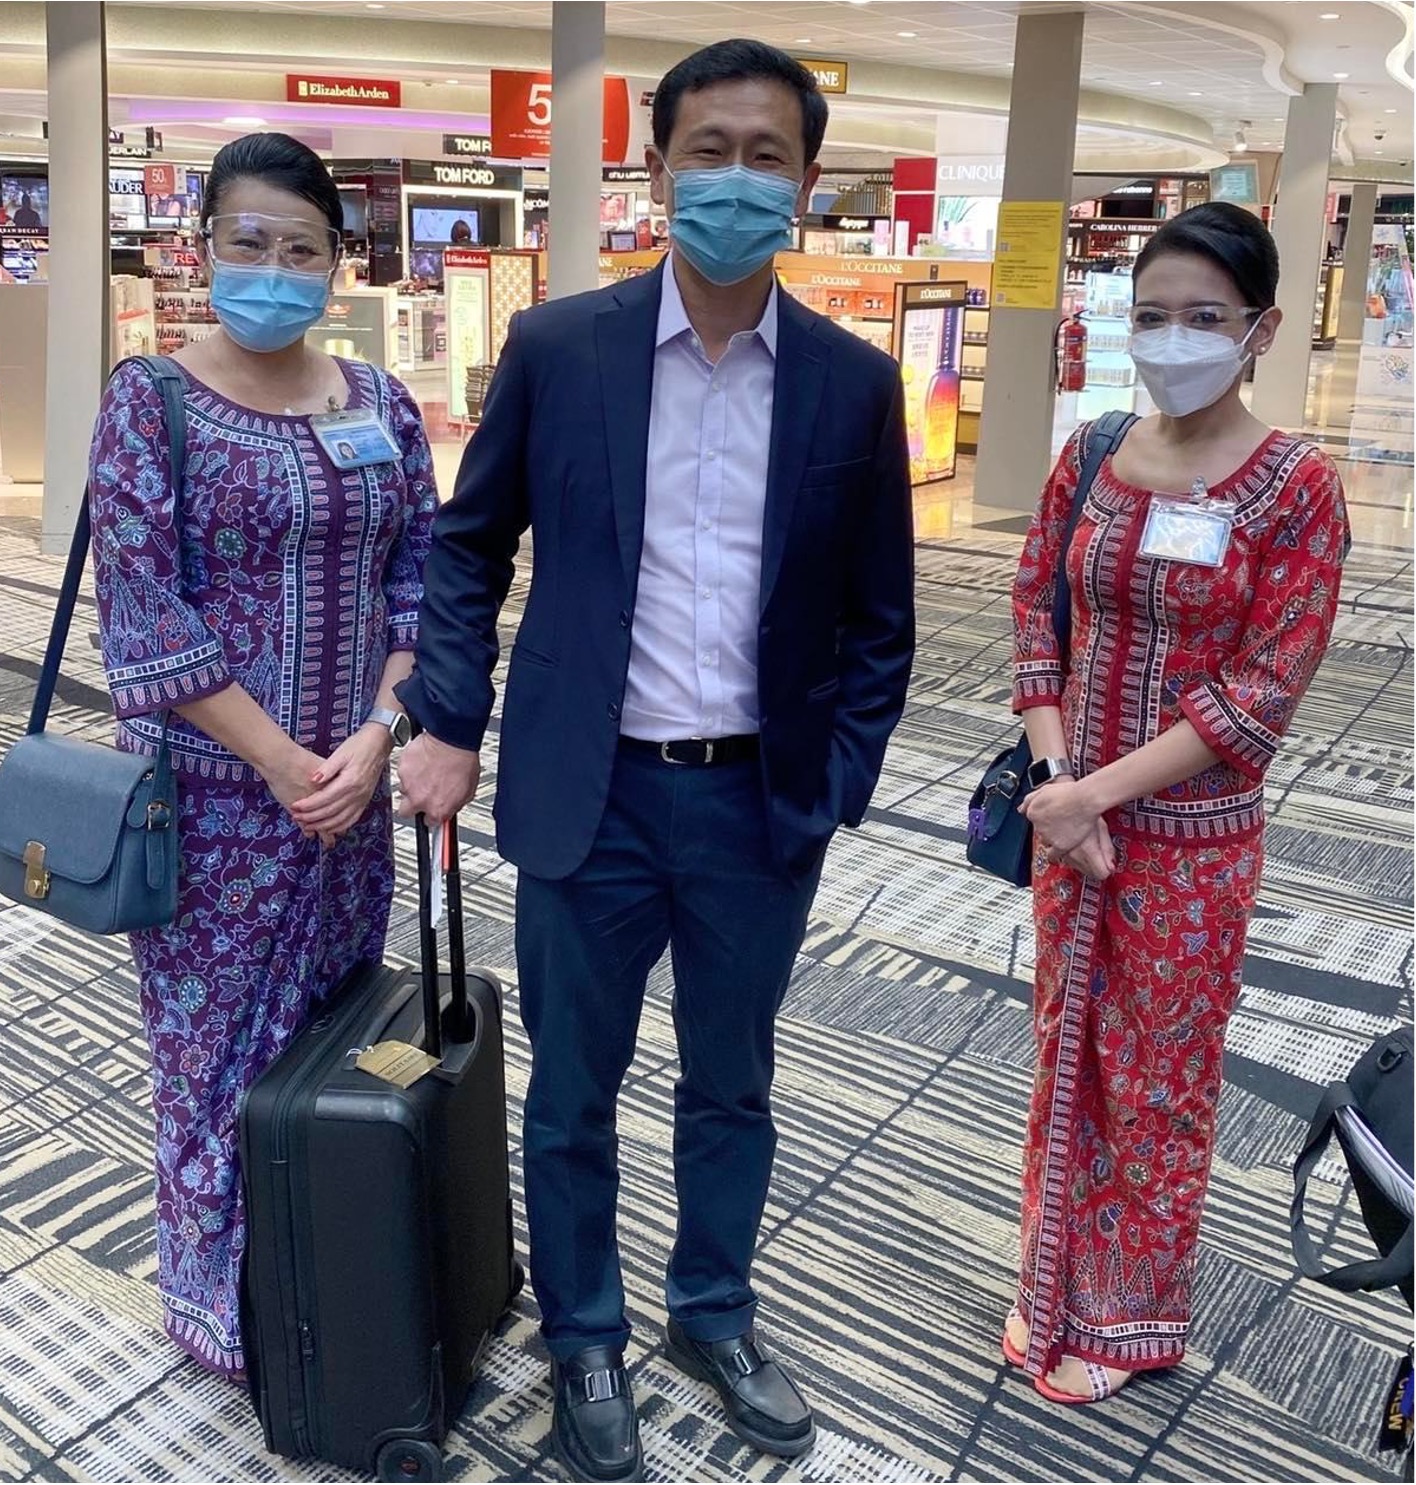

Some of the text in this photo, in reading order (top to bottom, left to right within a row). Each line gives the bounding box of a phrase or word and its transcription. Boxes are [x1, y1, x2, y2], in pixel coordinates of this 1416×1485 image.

[454, 138, 481, 152] TOM
[434, 167, 495, 185] TOM FORD
